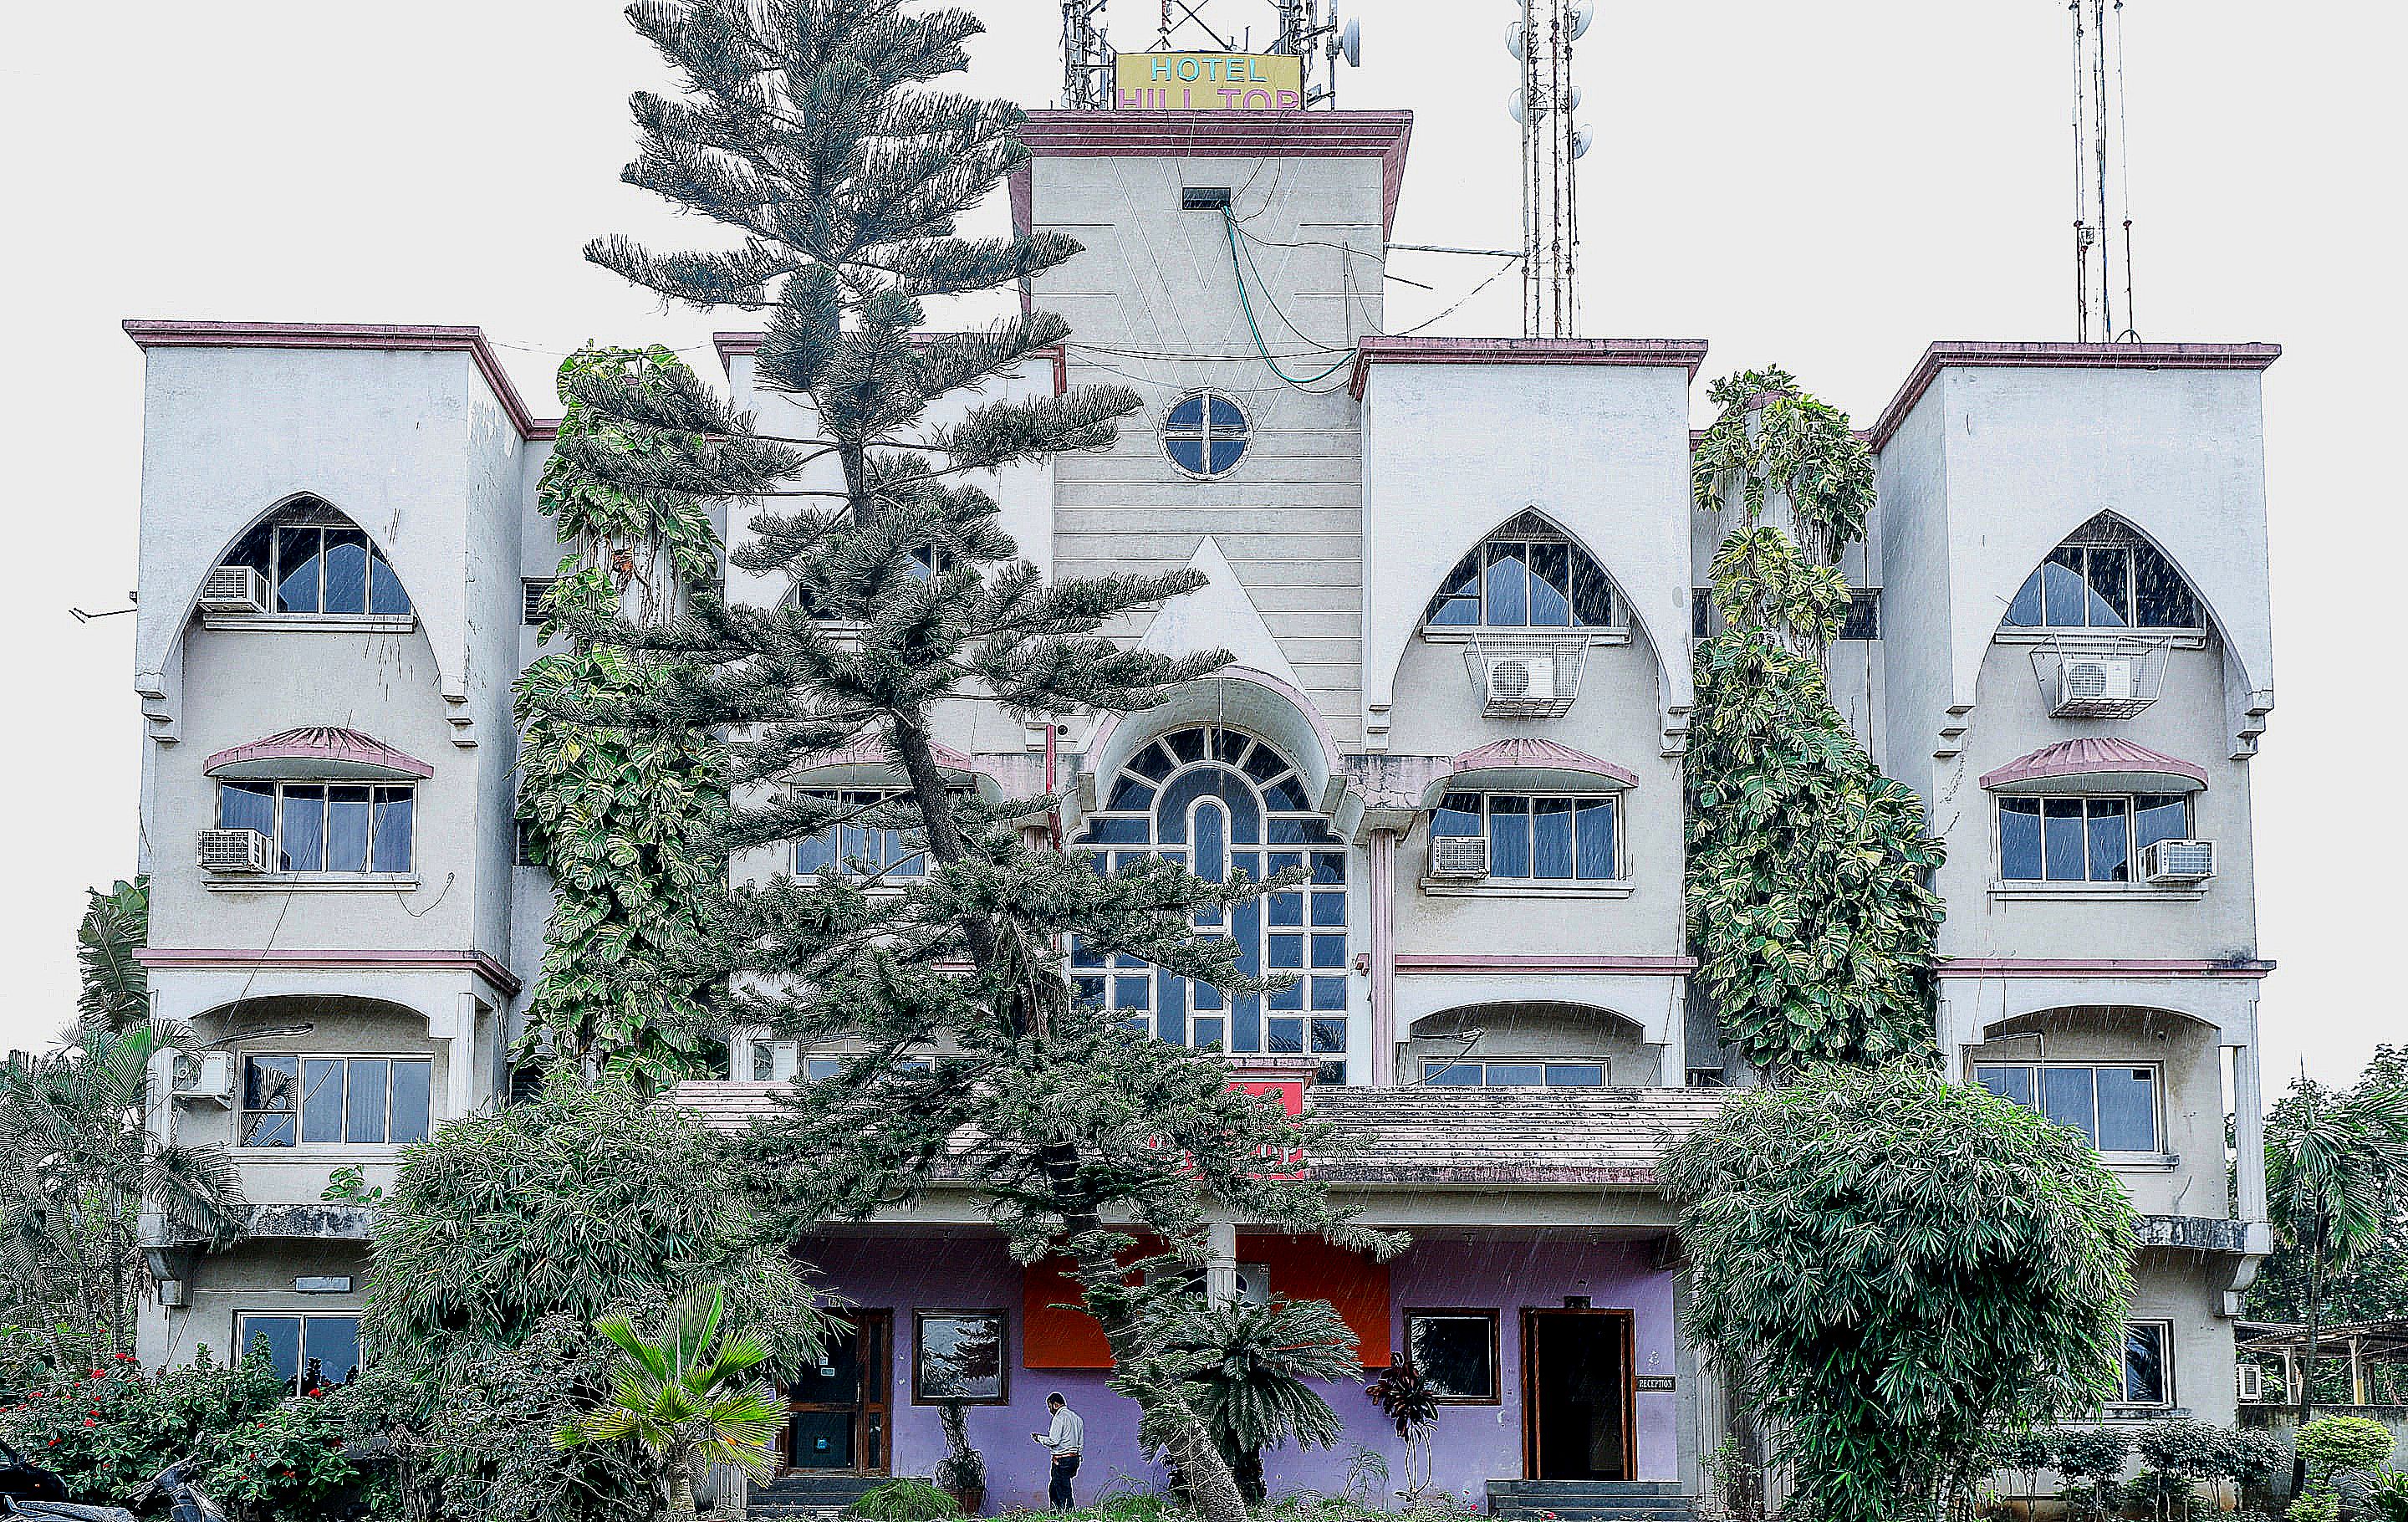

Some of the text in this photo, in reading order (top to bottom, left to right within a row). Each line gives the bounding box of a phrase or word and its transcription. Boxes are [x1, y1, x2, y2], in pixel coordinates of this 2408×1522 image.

[1150, 57, 1268, 81] HOTEL
[1217, 89, 1298, 108] TOP
[1639, 1379, 1673, 1388] RECEPTION
